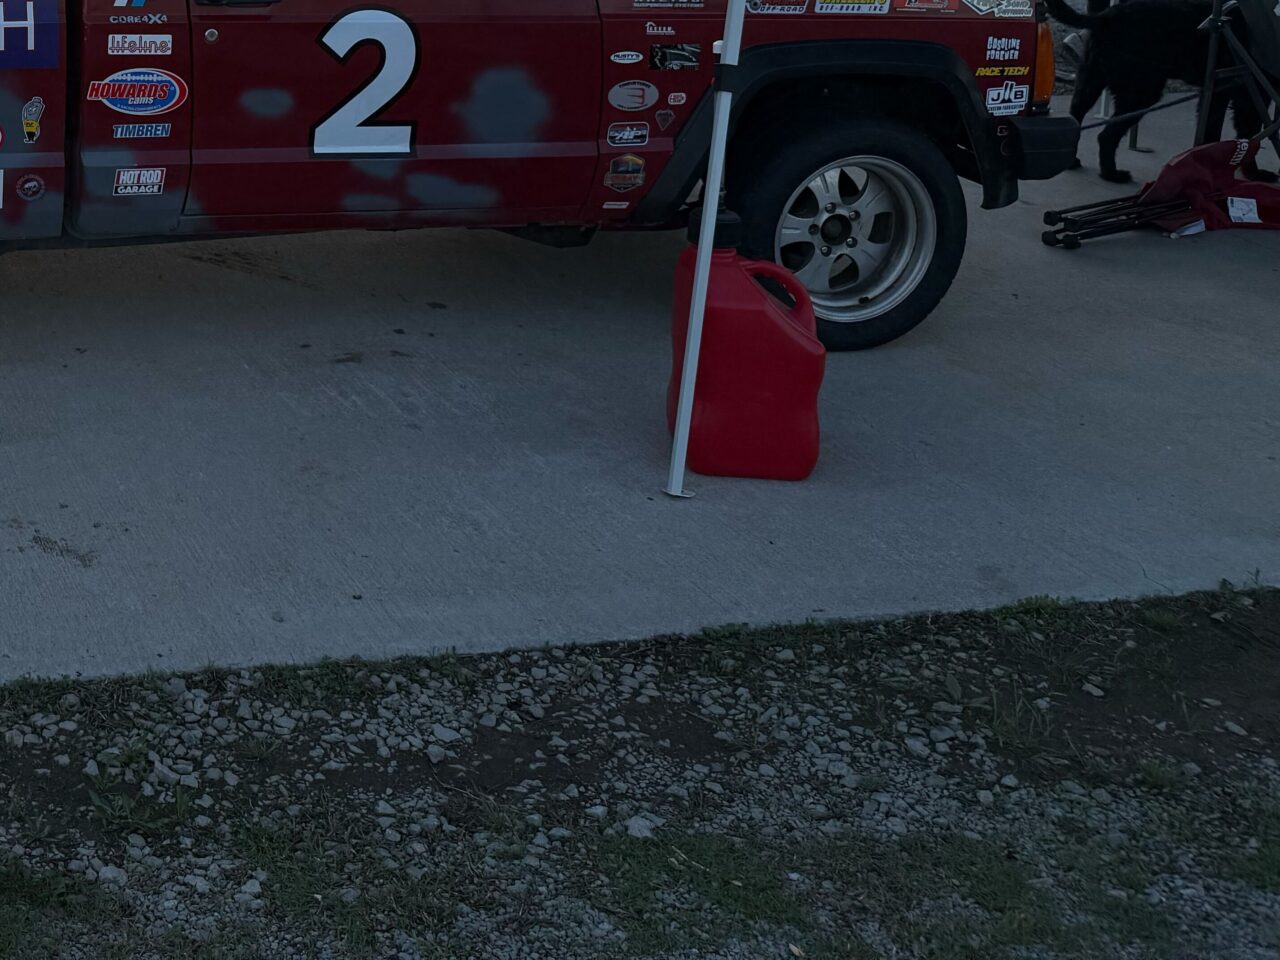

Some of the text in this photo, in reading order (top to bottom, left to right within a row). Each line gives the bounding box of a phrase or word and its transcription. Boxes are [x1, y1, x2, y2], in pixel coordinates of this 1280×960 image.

[987, 36, 1021, 50] GASOLINE
[987, 50, 1019, 61] FOREVER
[976, 66, 1030, 76] RACE TECH
[312, 8, 418, 155] 2
[88, 82, 169, 100] HOWARDS
[114, 125, 170, 138] TIMBREN
[120, 170, 162, 184] HOT ROD
[117, 185, 160, 193] GARAGE
